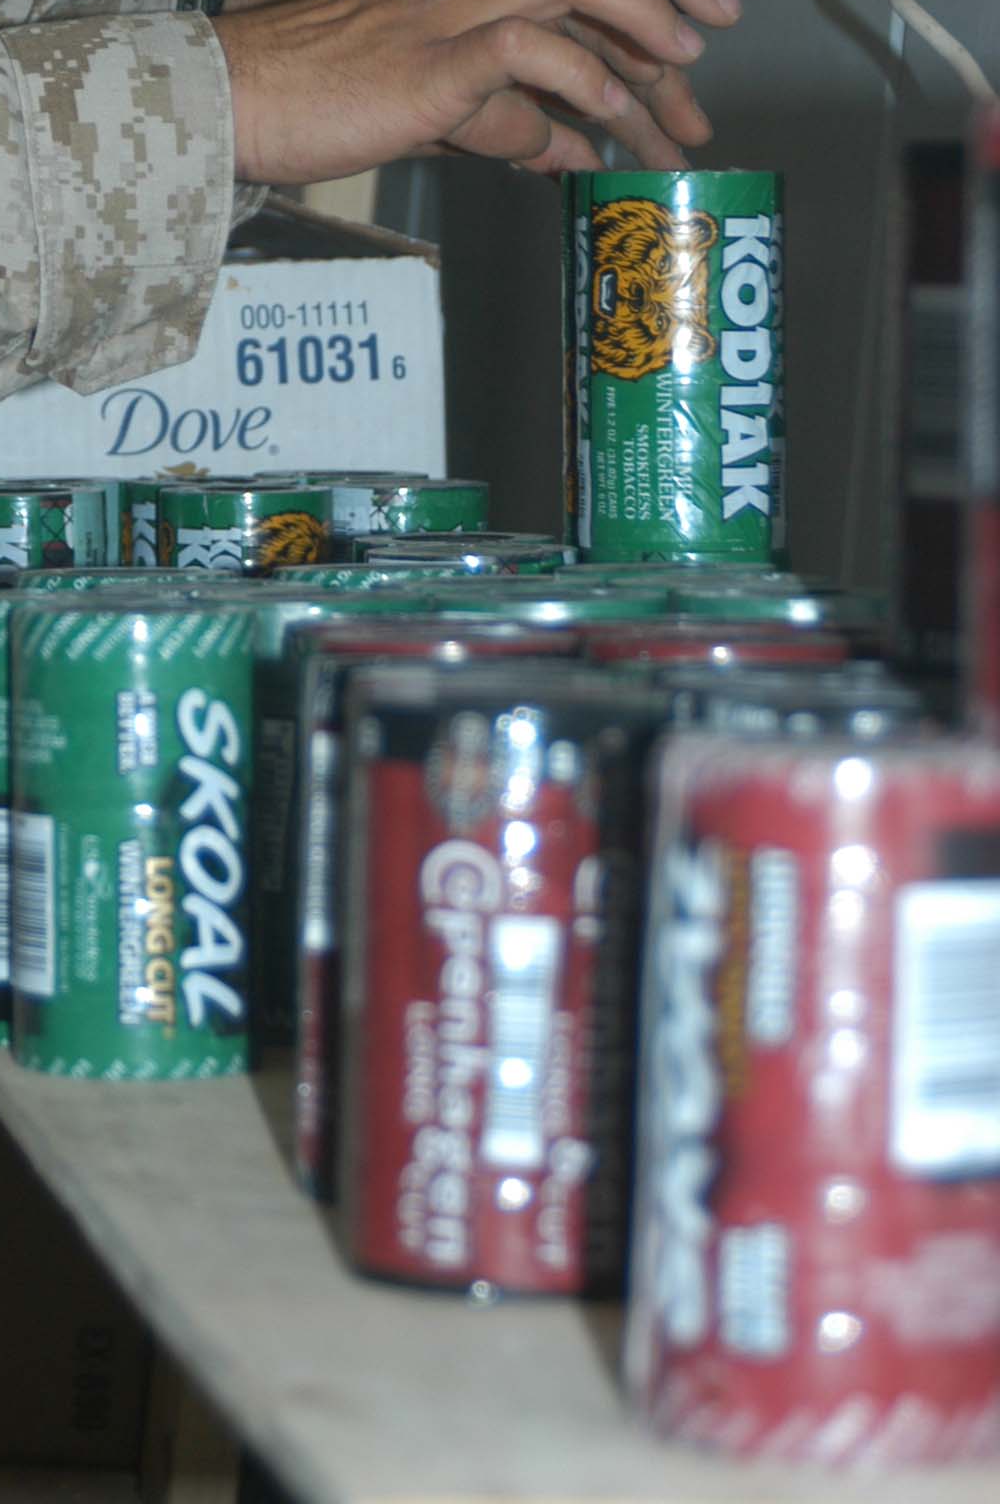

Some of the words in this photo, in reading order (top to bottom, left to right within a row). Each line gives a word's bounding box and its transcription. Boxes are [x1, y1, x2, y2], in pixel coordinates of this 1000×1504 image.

[236, 332, 382, 386] 61031
[391, 355, 407, 381] 6
[240, 300, 370, 330] 000-11111
[720, 213, 772, 521] KODIAK
[100, 387, 273, 457] Dove
[656, 372, 674, 522] WINTERGREEN
[622, 438, 637, 521] TOBACCO
[636, 424, 651, 521] SMOKELESS
[176, 687, 245, 1028] SKOAL
[145, 855, 175, 955] LONG
[144, 957, 175, 1025] CUT
